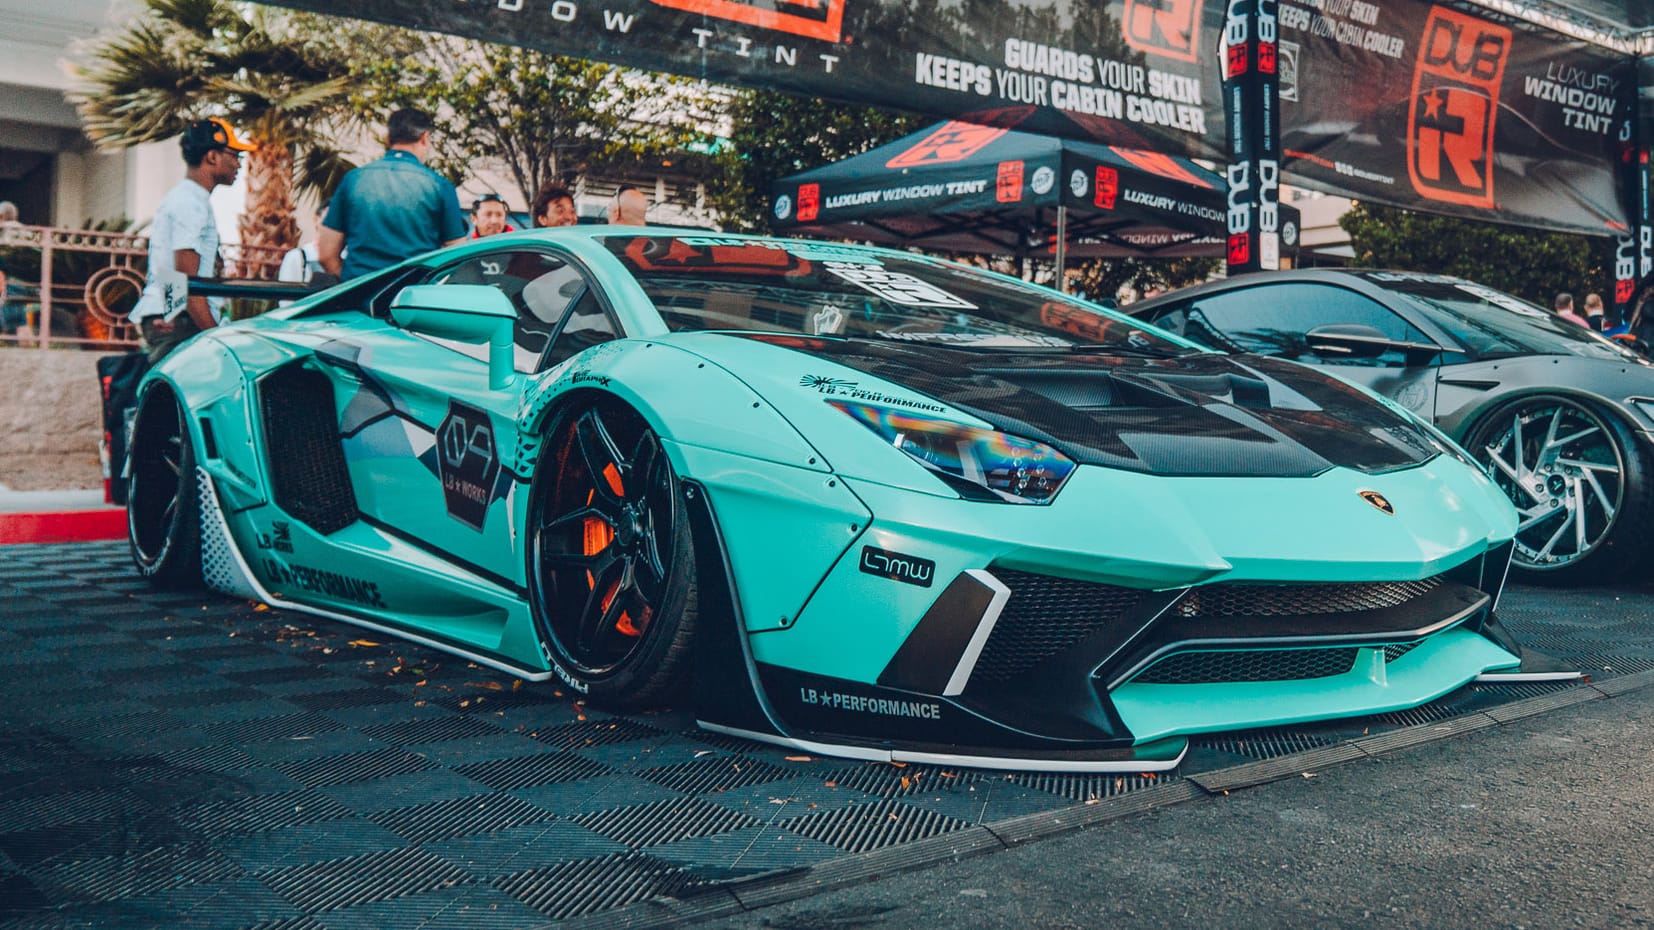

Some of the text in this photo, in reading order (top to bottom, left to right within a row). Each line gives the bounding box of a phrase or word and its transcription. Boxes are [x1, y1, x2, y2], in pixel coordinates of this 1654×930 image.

[1349, 1, 1380, 25] SKIN
[692, 28, 839, 73] TINT
[1310, 15, 1336, 39] YOUR
[1335, 21, 1365, 46] CABIN
[1363, 30, 1404, 59] COOLER
[1424, 16, 1505, 81] DUB
[1005, 38, 1201, 105] GUARDS YOUR SKIN
[1546, 61, 1620, 95] LUXURY
[915, 52, 992, 96] KEEPS
[996, 68, 1047, 106] YOUR
[1050, 80, 1122, 119] CABIN
[1126, 94, 1207, 134] COOLER
[1524, 76, 1616, 115] WINDOW
[1562, 108, 1612, 135] TINT
[825, 190, 882, 209] LUXURY
[882, 183, 945, 201] WINDOW
[946, 179, 987, 195] TINT
[1123, 189, 1226, 222] LUXURY WINDOW
[1227, 161, 1250, 235] DUB
[1259, 159, 1278, 232] DUB
[818, 386, 948, 414] LB PERFORMANCE
[462, 480, 487, 505] WORKS
[288, 564, 388, 609] PERFORMANCE
[800, 687, 941, 720] LB PERFORMANCE
